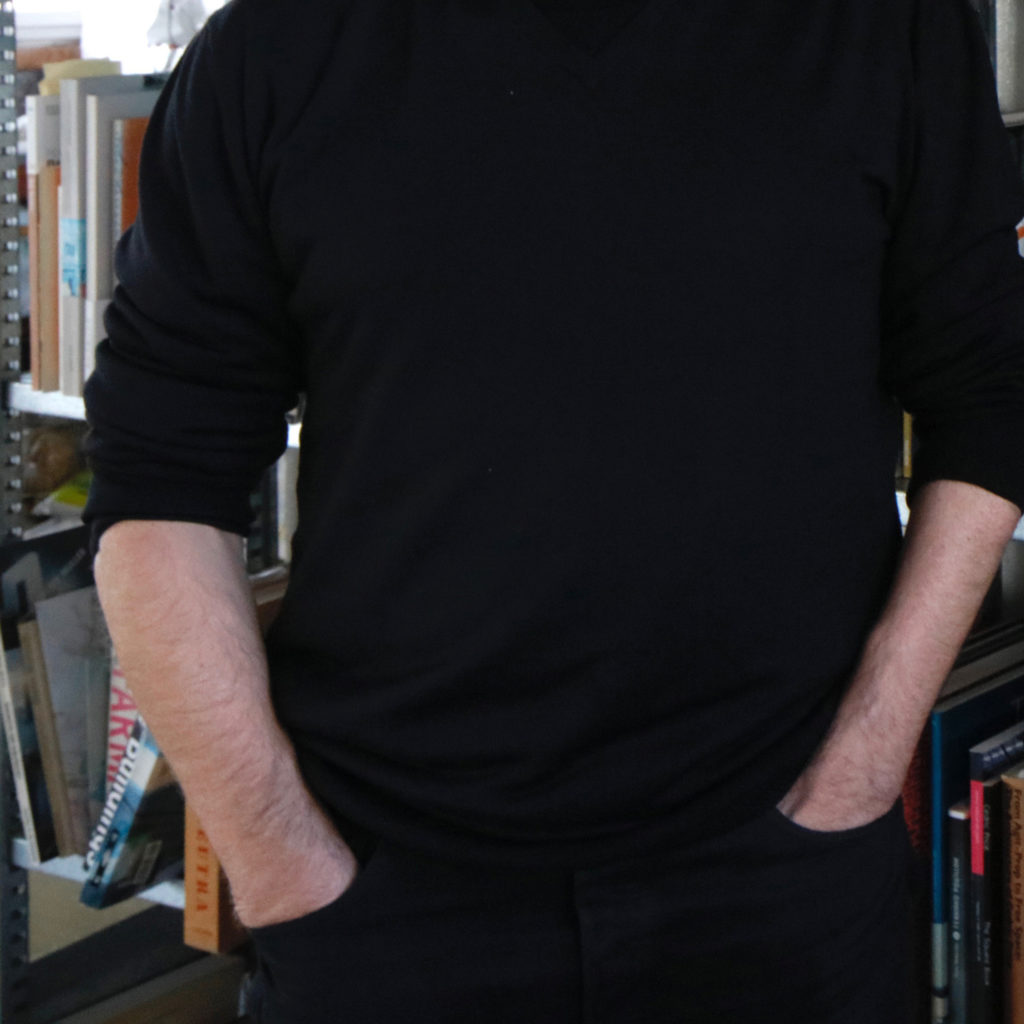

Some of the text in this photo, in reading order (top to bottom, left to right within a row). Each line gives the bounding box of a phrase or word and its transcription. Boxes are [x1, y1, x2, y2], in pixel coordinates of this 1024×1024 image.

[1013, 788, 1023, 820] From
[1014, 882, 1022, 895] to
[1014, 897, 1023, 923] Free
